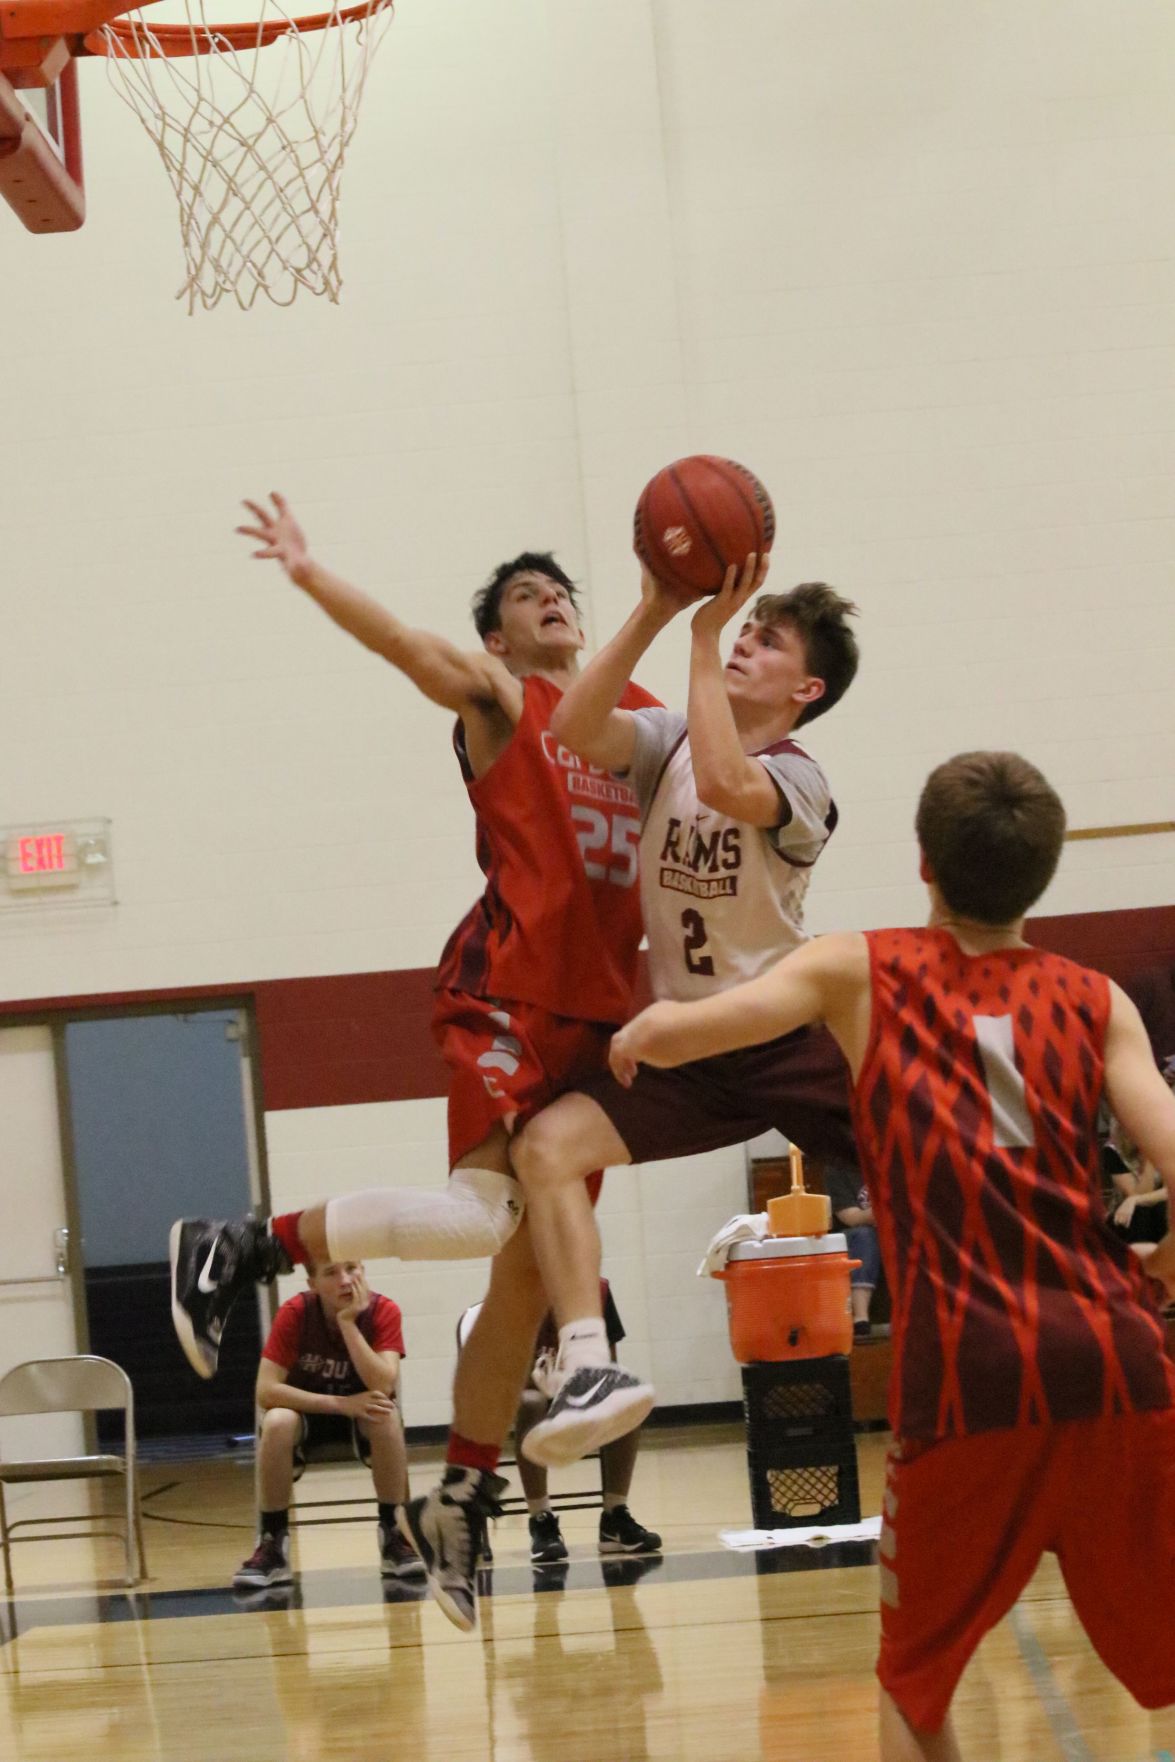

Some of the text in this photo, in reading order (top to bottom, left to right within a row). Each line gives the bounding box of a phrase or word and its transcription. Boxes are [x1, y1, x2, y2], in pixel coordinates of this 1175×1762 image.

[19, 834, 64, 872] EXIT
[571, 805, 641, 888] 25
[681, 908, 715, 976] 2
[972, 1013, 1035, 1147] 1
